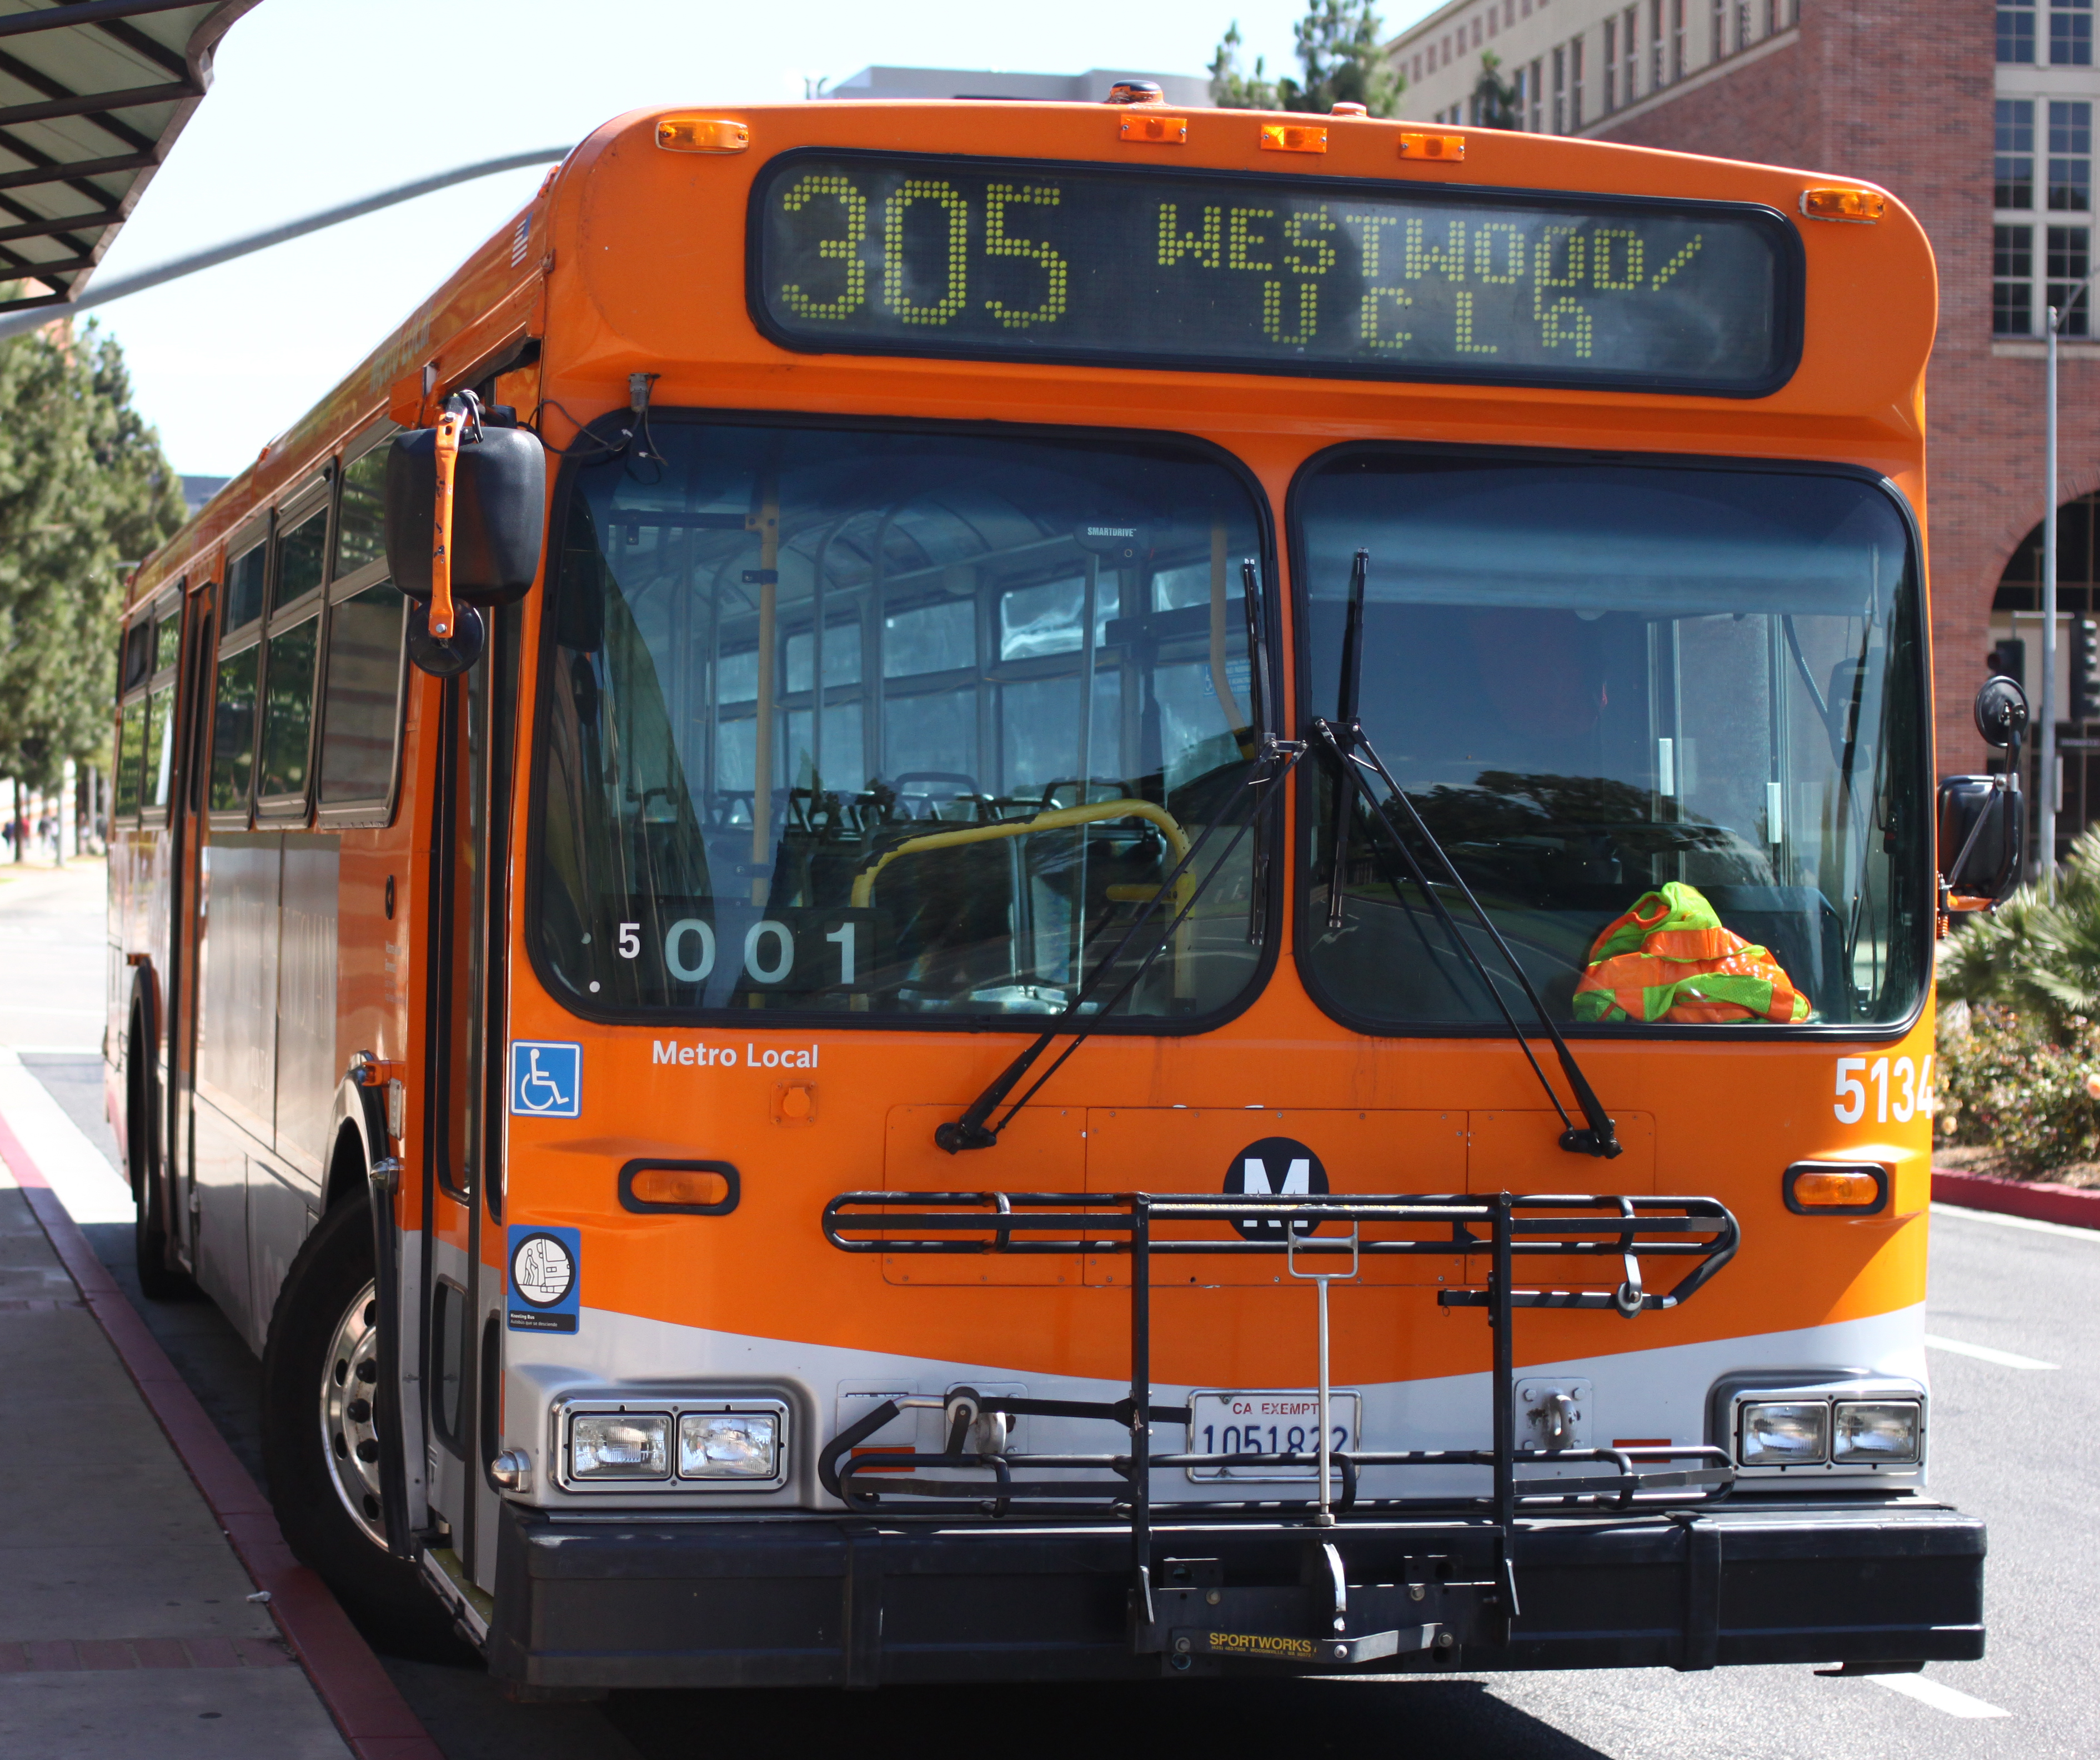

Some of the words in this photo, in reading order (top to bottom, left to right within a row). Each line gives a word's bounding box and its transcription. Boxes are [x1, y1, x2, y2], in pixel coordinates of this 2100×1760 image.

[783, 176, 1067, 327] 305
[1158, 203, 1703, 291] WESTWOOD/
[618, 923, 640, 958] 5
[665, 918, 856, 984] 001
[653, 1040, 737, 1067] Metro
[747, 1043, 819, 1068] Local
[1834, 1054, 1934, 1124] 5134
[1232, 1403, 1252, 1414] CA
[1261, 1403, 1320, 1415] EXEMPT
[1209, 1632, 1311, 1653] SPORTWORKS
